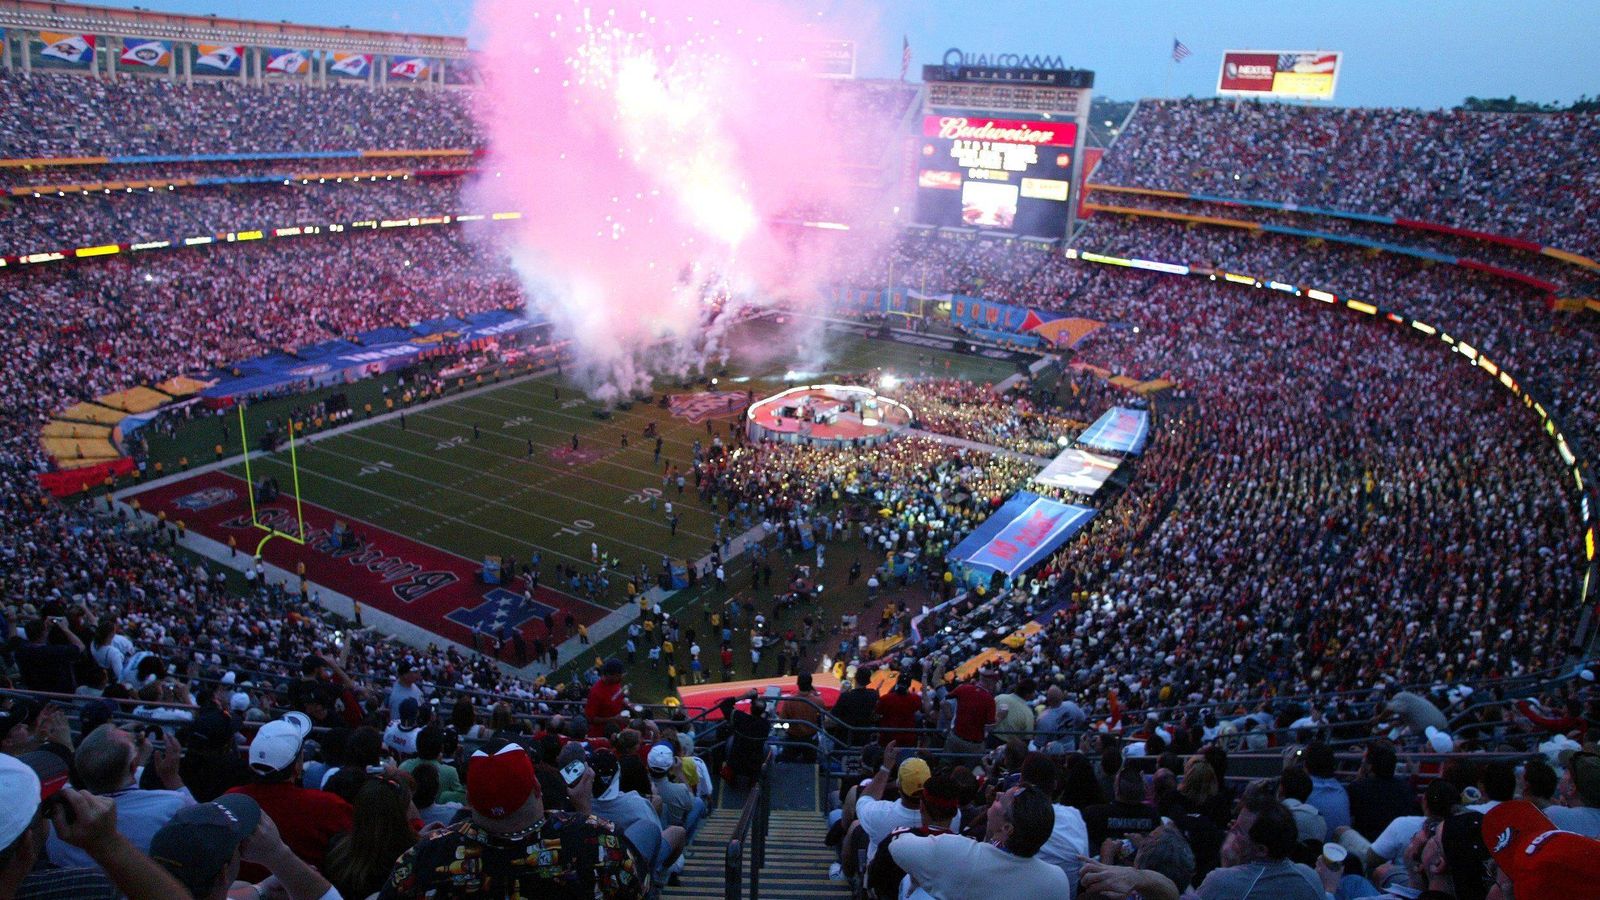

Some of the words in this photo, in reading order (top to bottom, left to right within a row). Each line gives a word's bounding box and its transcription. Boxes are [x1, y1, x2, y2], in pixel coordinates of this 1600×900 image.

[943, 48, 1065, 77] QUALCOMM
[966, 70, 1056, 81] STADIUM
[939, 117, 1054, 142] Budweiser
[560, 518, 595, 536] 10
